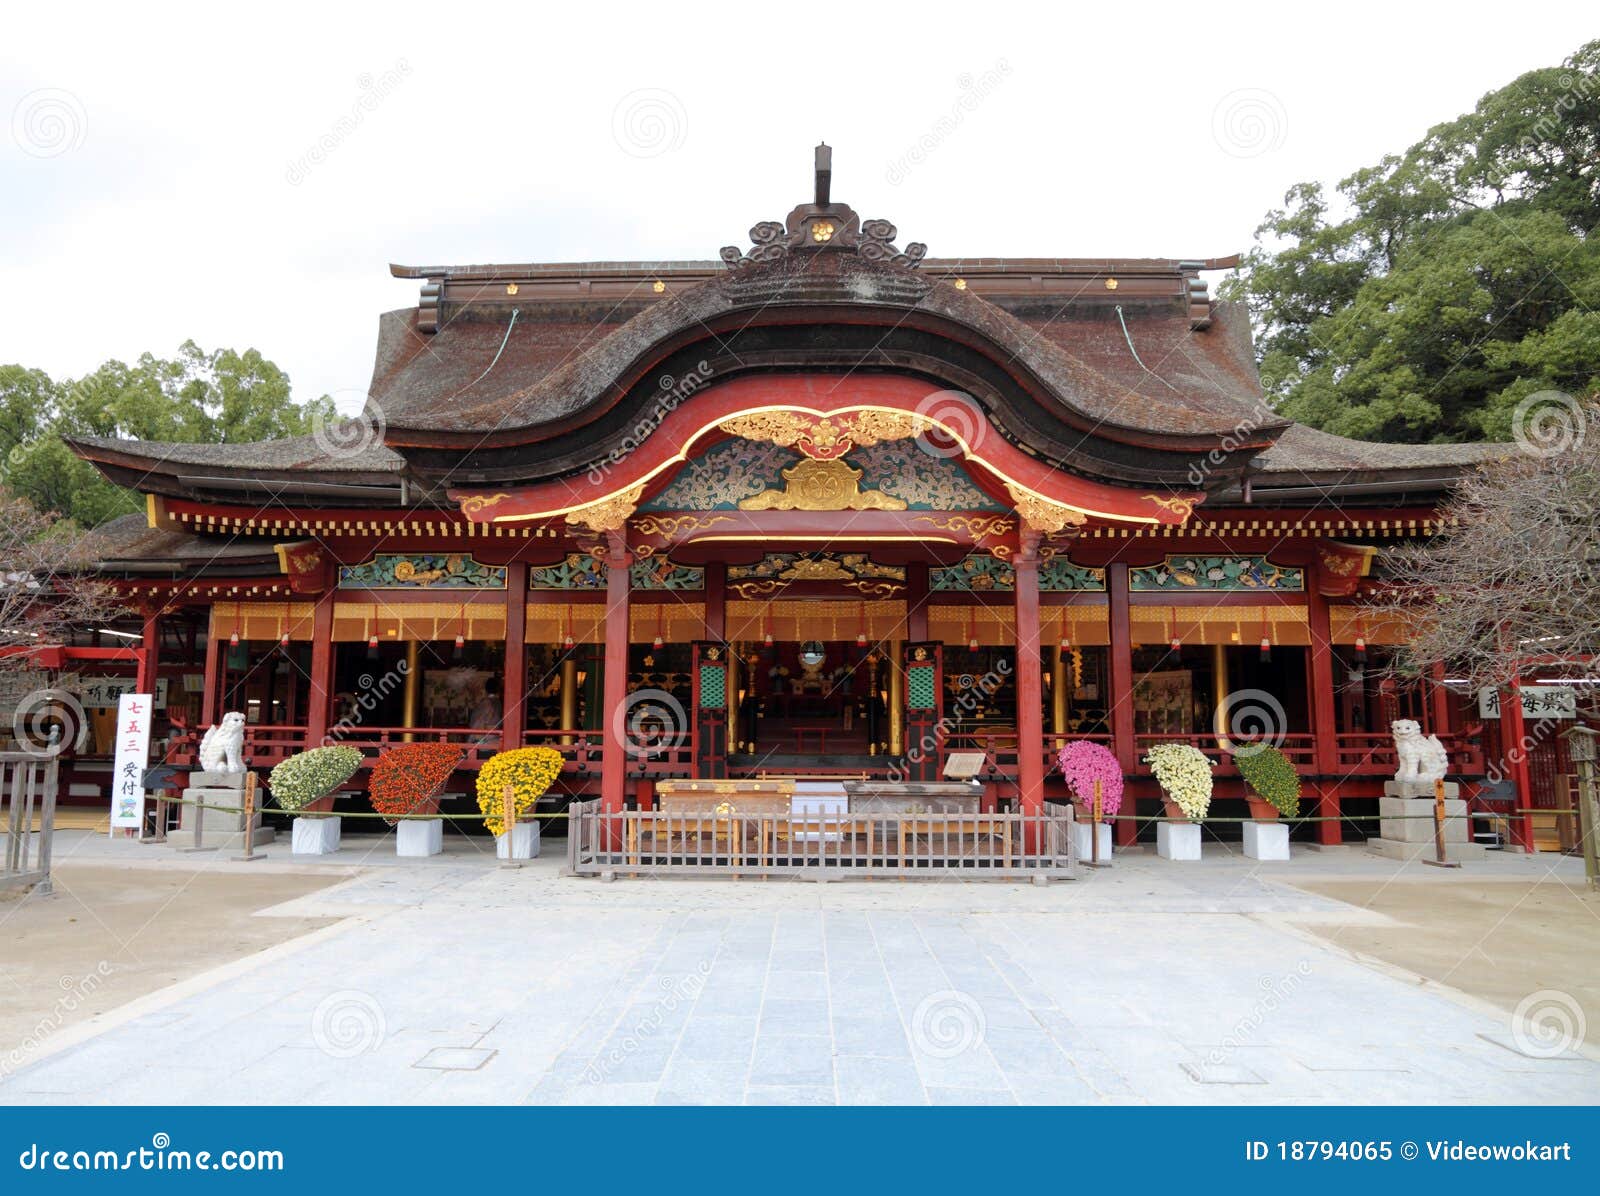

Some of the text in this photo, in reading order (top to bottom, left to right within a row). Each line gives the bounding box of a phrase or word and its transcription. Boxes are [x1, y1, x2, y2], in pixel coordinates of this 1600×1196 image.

[121, 701, 144, 796] 七五三 受付
